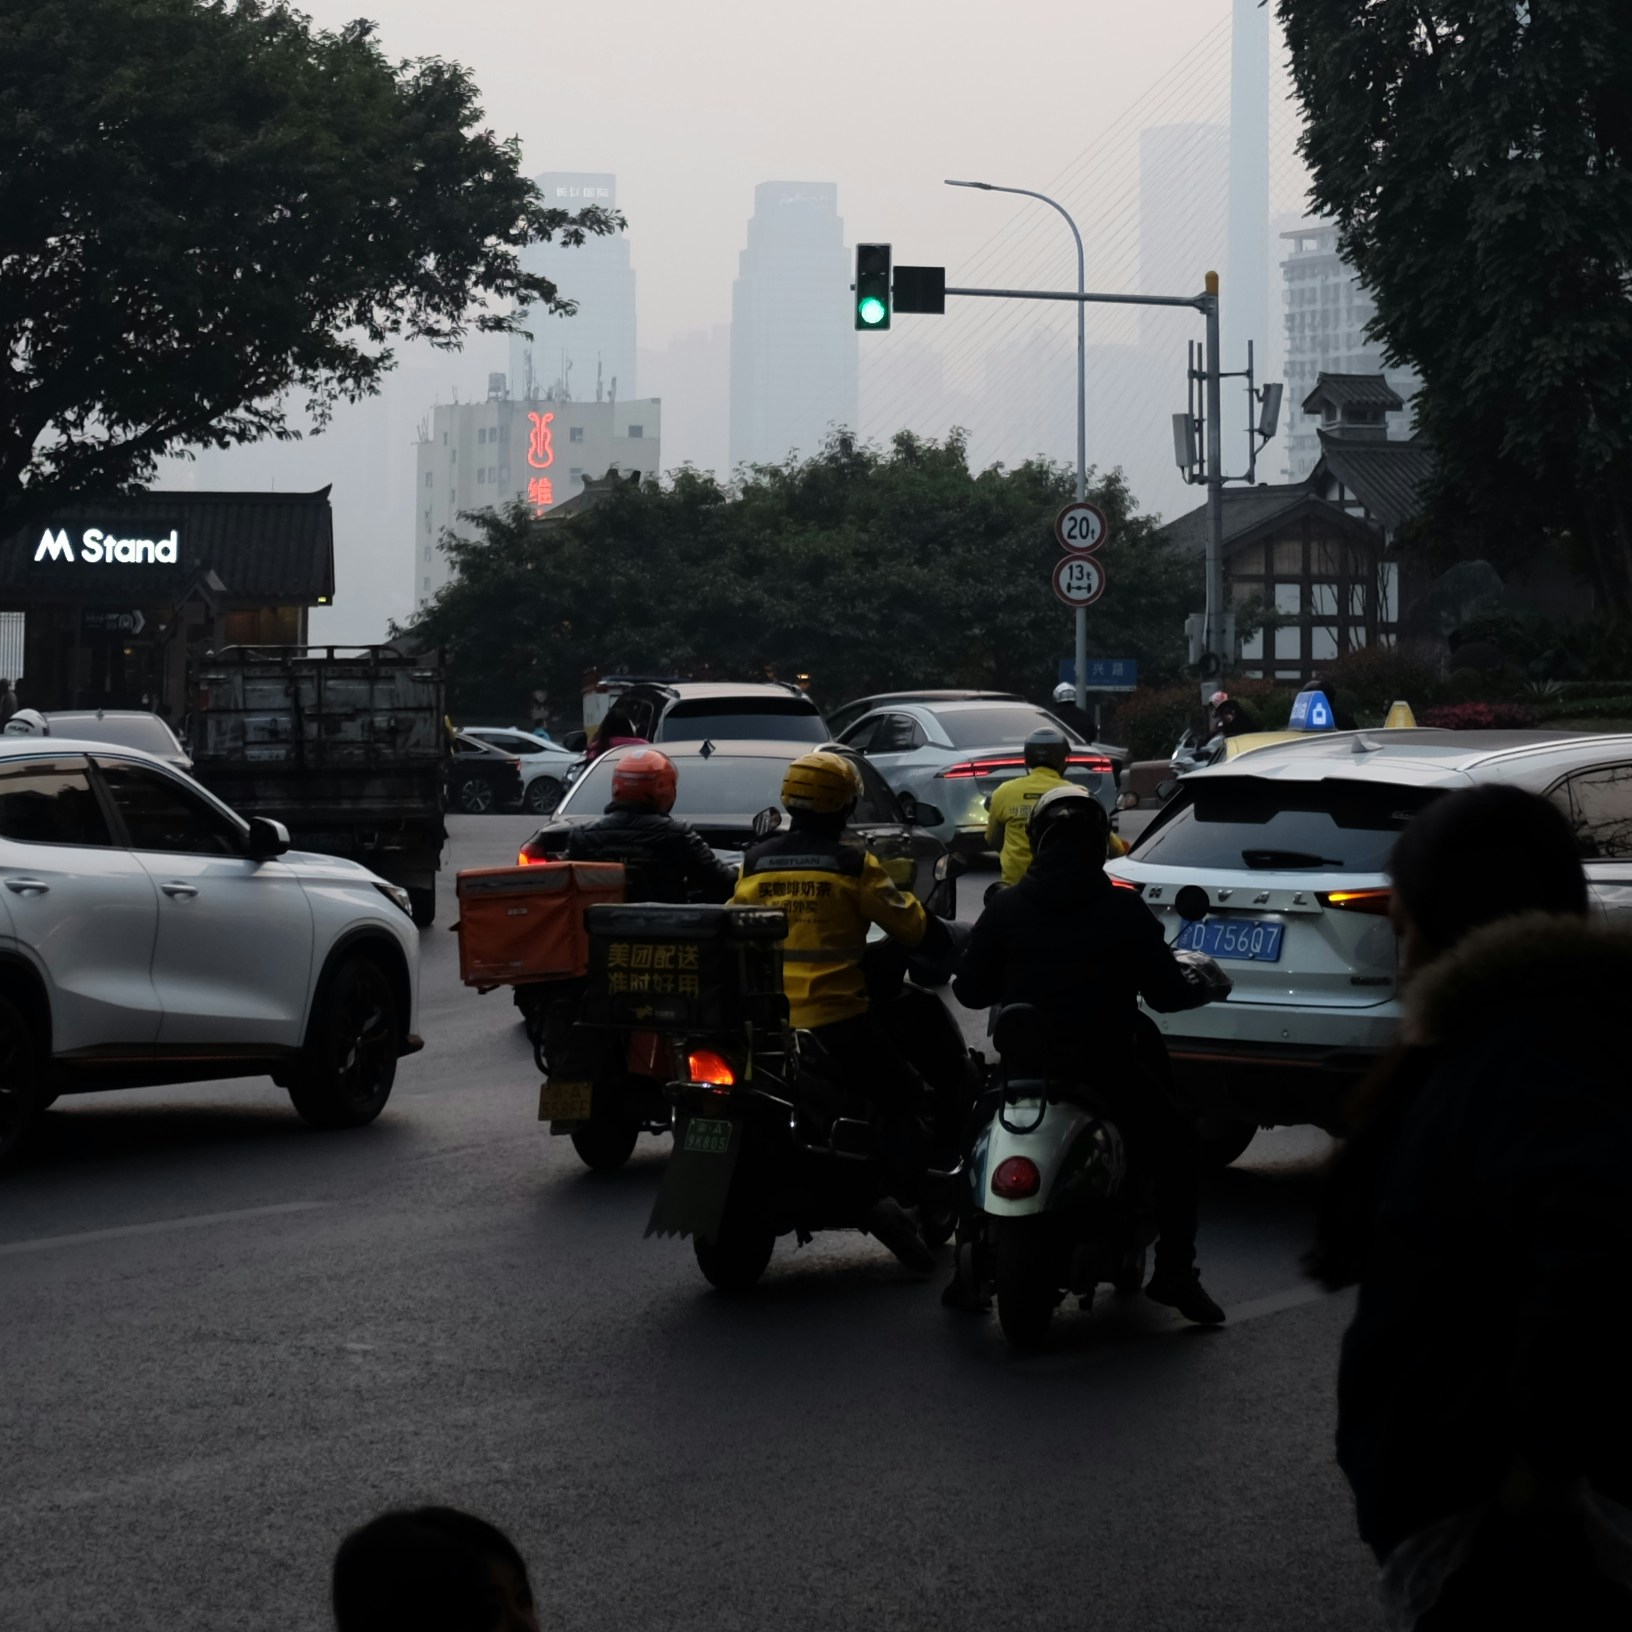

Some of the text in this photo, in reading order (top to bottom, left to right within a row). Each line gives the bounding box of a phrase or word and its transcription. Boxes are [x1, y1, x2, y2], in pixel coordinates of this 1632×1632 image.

[1067, 516, 1095, 541] 20t
[33, 527, 179, 564] M Stand
[1068, 564, 1092, 581] 13t
[1073, 661, 1124, 676] 兴路
[769, 856, 820, 866] MEITUAN
[759, 880, 833, 898] 买咖啡奶茶
[1149, 886, 1308, 906] HVAL
[608, 942, 701, 970] 美团配送
[608, 971, 700, 999] 准时好用
